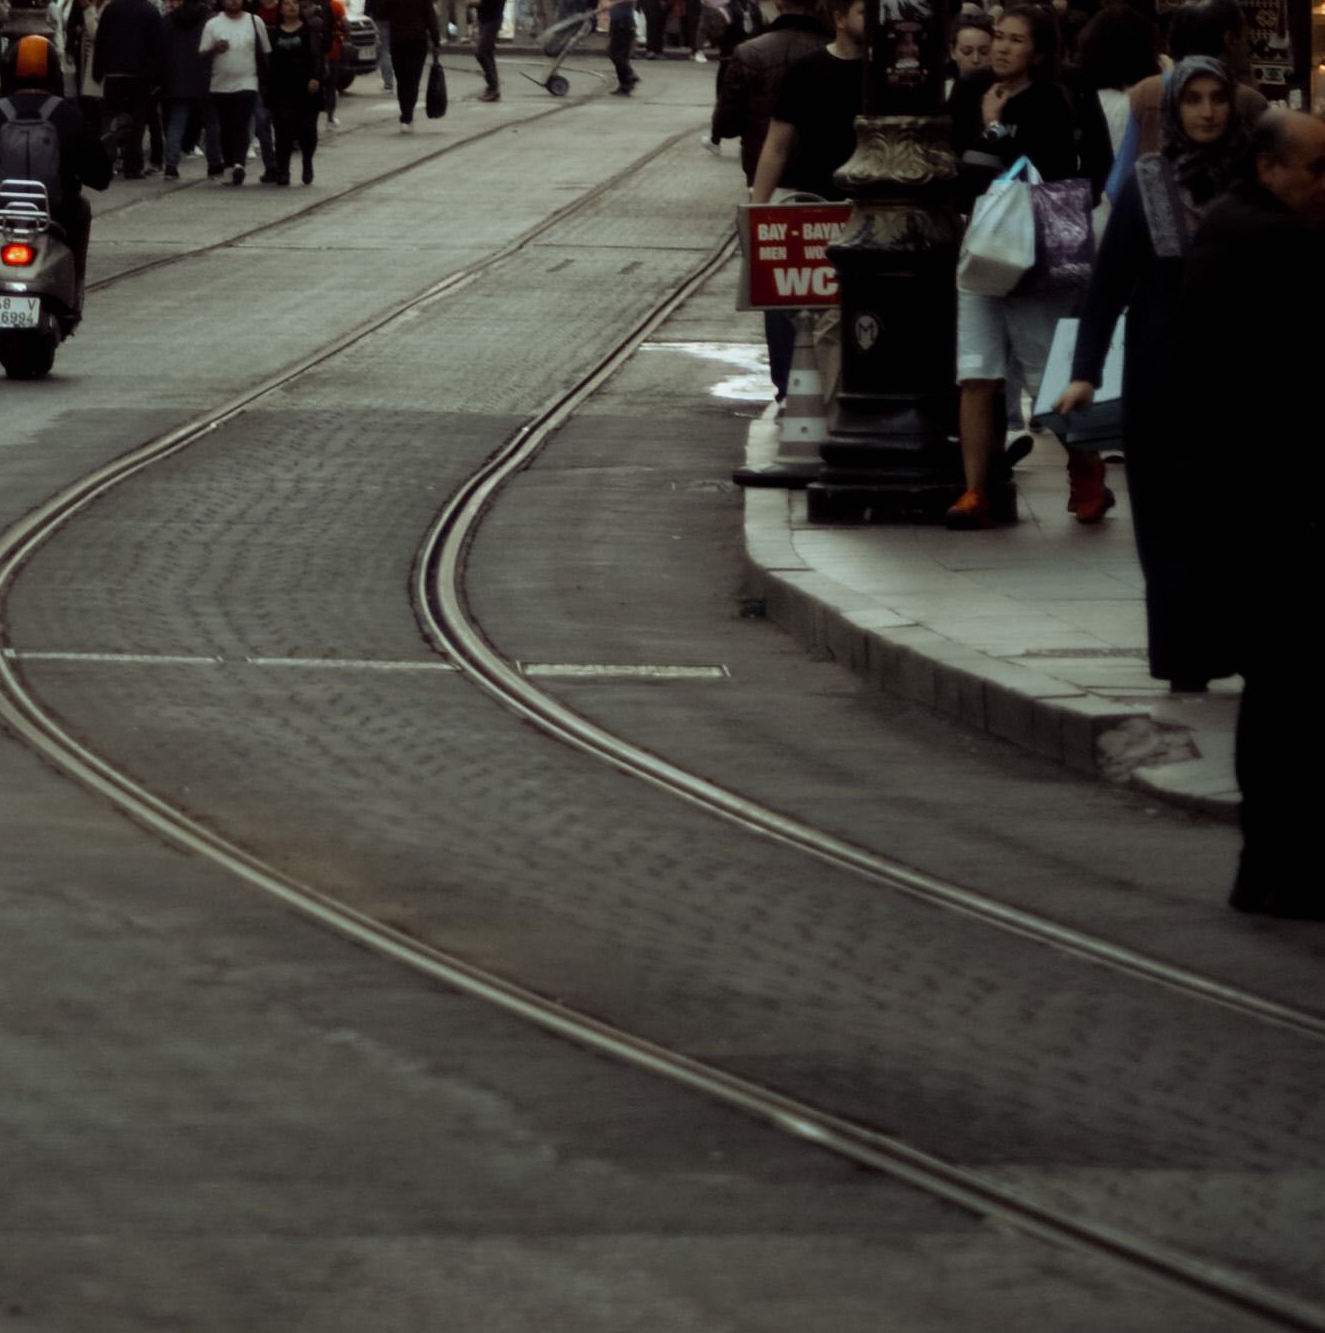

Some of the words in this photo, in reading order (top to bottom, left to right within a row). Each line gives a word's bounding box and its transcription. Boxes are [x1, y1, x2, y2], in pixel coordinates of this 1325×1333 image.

[757, 222, 788, 241] BAY
[803, 222, 846, 240] BAYA
[759, 245, 787, 261] MEN
[804, 244, 827, 260] WO
[773, 266, 839, 296] WC
[27, 299, 37, 310] V
